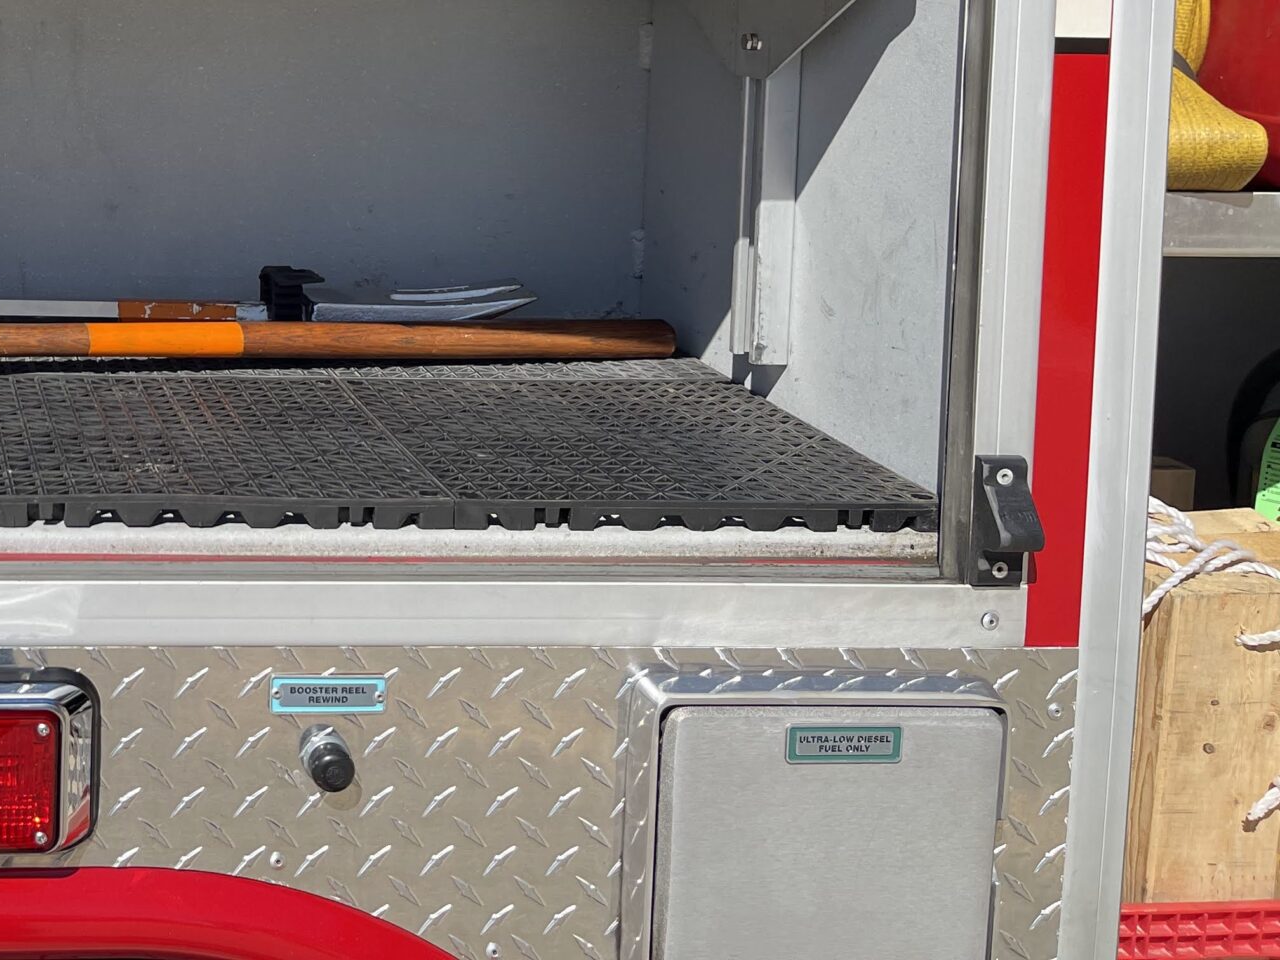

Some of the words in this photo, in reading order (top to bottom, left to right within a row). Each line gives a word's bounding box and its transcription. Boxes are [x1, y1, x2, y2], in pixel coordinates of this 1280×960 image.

[289, 686, 338, 695] BOOSTER
[341, 686, 367, 695] REEL
[308, 696, 349, 704] REWIND
[799, 735, 855, 744] ULTRA-LOW
[857, 735, 891, 743] DIESEL
[818, 744, 843, 753] FUEL
[845, 744, 871, 753] ONLY
